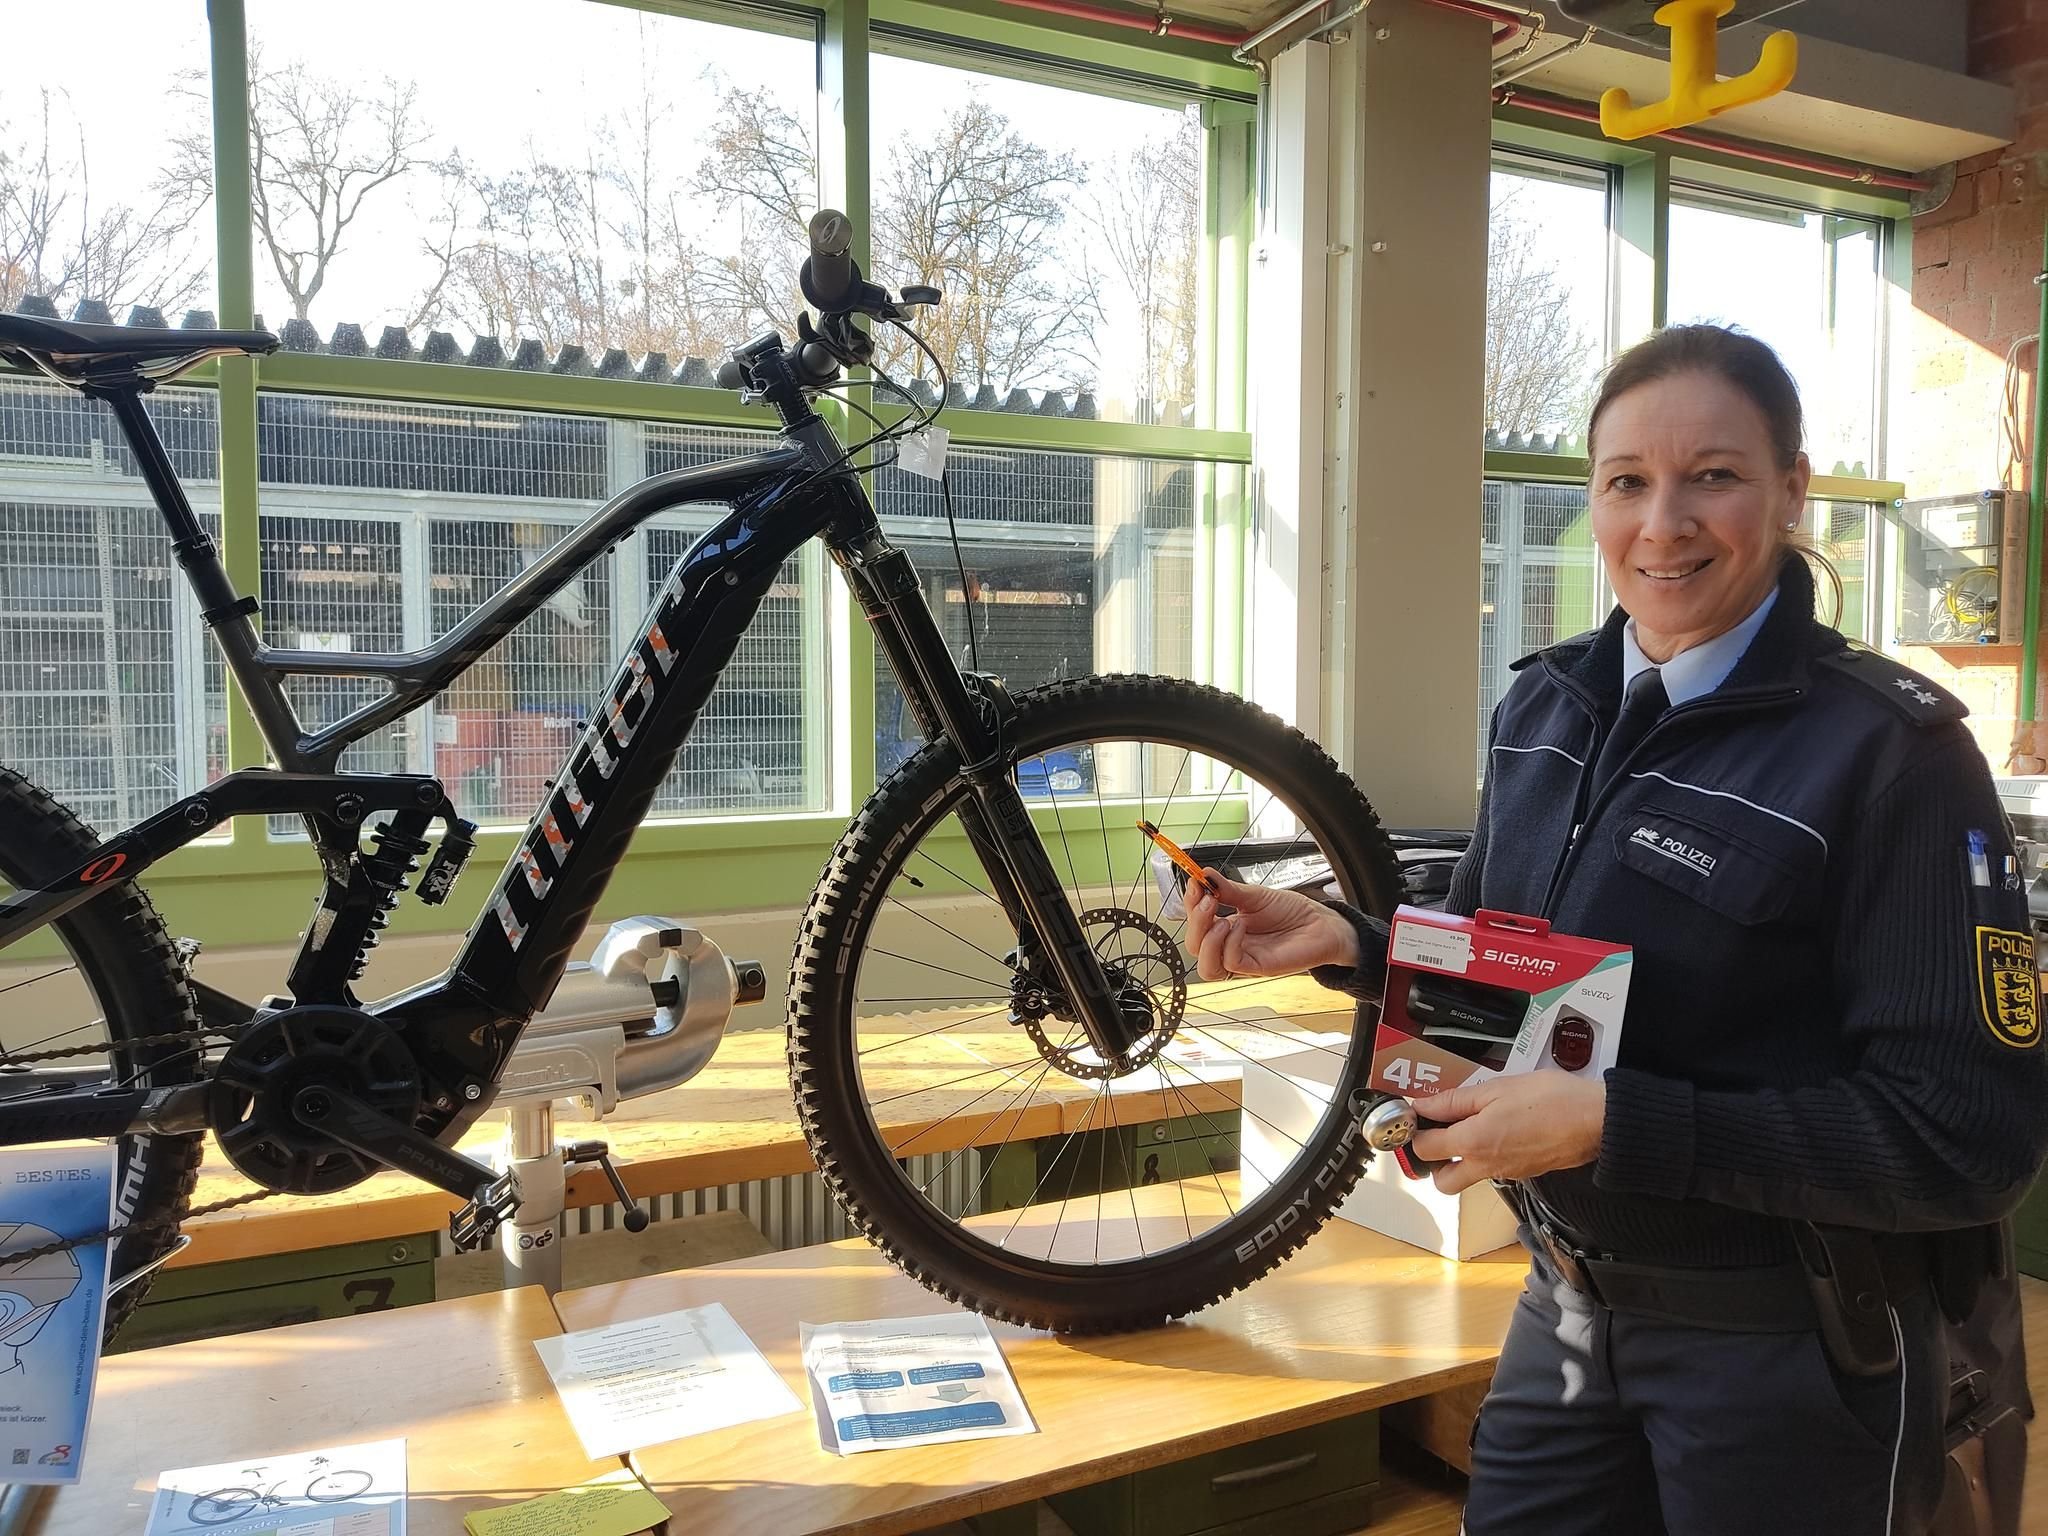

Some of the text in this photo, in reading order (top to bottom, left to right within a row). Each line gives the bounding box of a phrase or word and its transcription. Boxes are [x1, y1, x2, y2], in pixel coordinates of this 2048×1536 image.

[1661, 836, 1717, 871] POLIZEI
[425, 860, 459, 896] FOX
[835, 775, 963, 975] SCHWALBE
[1482, 949, 1557, 972] SIGMA
[1988, 935, 2033, 959] POLIZEI
[1450, 1009, 1485, 1025] SIGMA
[1515, 1028, 1534, 1056] AUTO
[1525, 1002, 1544, 1031] LIGHT
[1561, 1030, 1588, 1039] SIGMA
[1382, 1057, 1441, 1090] 45
[1423, 1082, 1440, 1094] Lux
[397, 1144, 465, 1184] PRAXIS
[1234, 1116, 1361, 1264] EDDY CUR
[535, 1230, 553, 1248] GS
